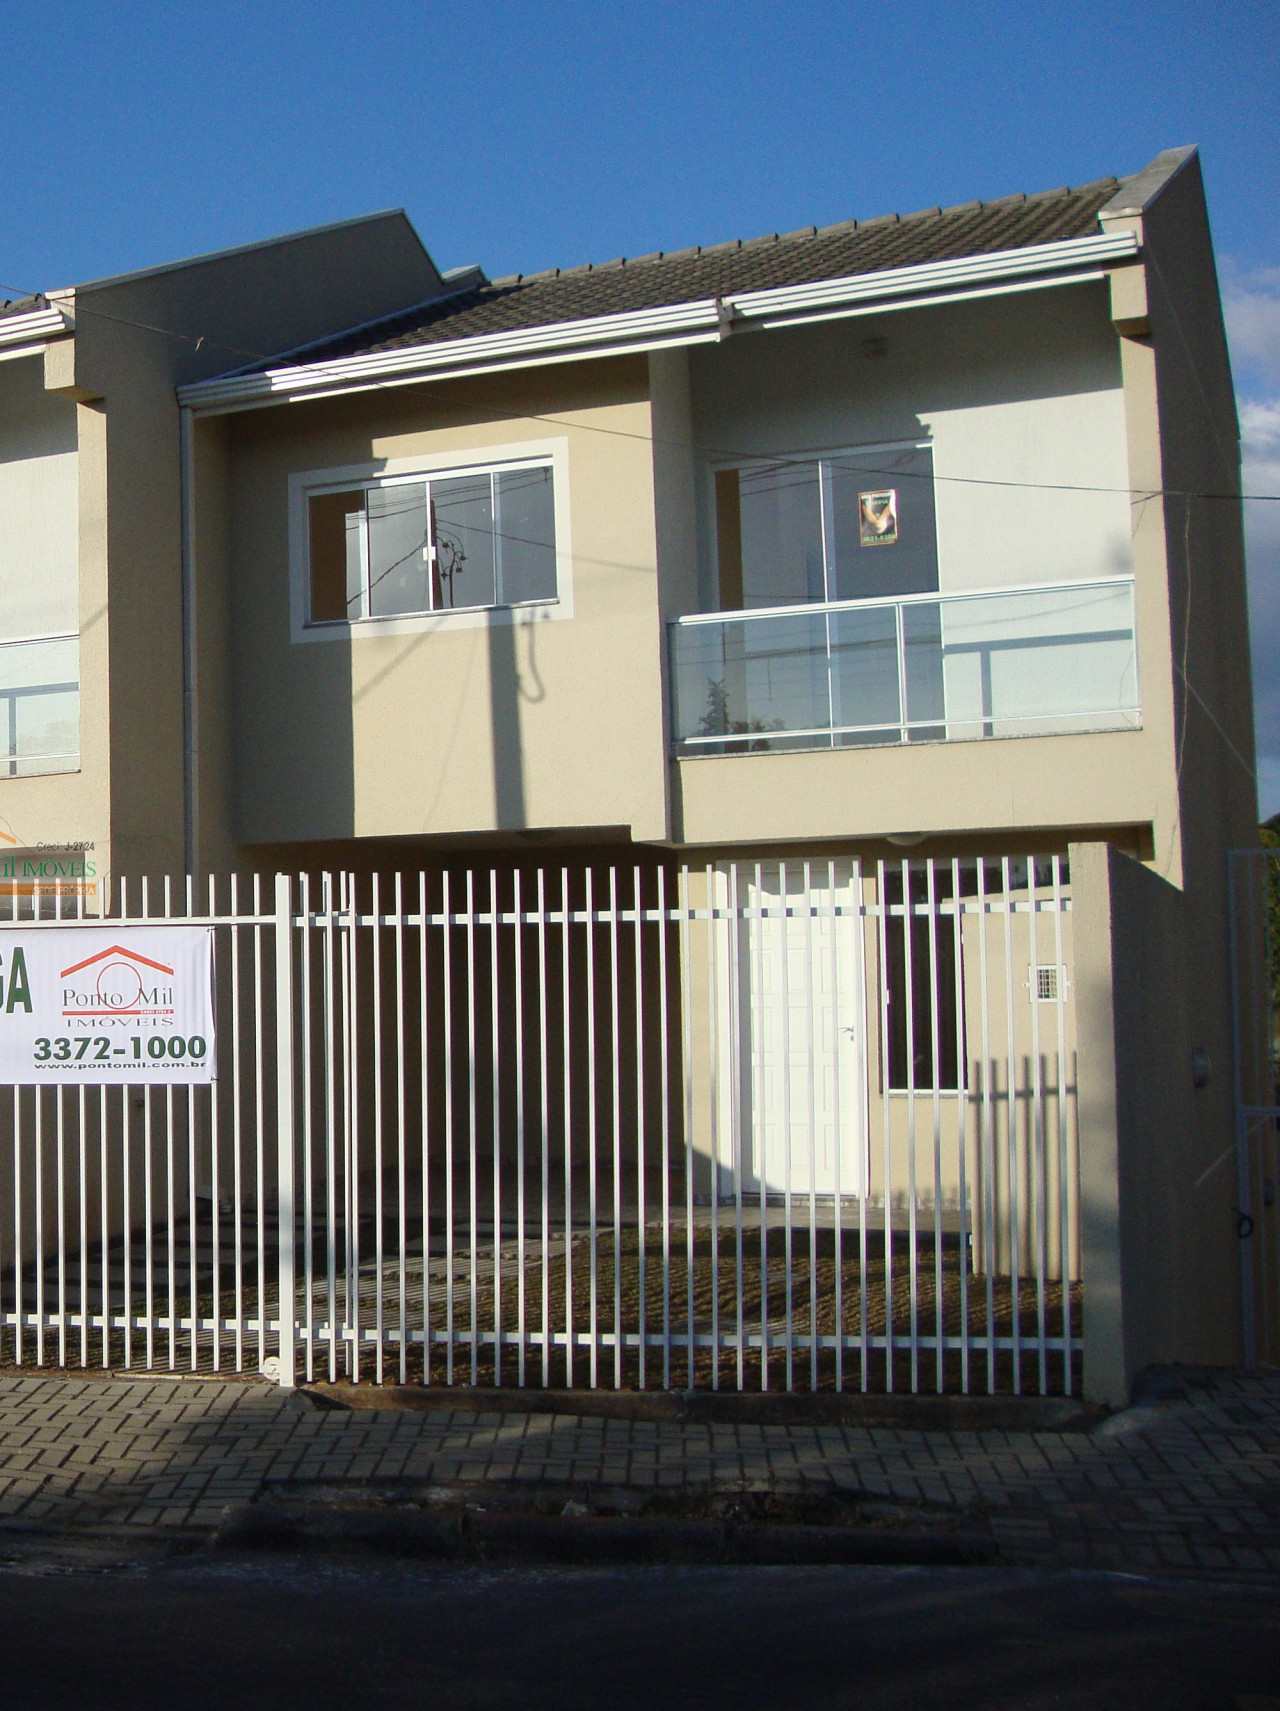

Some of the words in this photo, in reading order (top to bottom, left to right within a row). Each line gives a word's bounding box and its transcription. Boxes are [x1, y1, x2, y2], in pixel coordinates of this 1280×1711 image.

[62, 988, 123, 1007] Ponto
[138, 987, 173, 1006] Mil
[67, 1015, 174, 1028] IMÓVEIS
[33, 1035, 207, 1061] 3372-1000
[34, 1061, 207, 1070] www.pontomil.com.br
